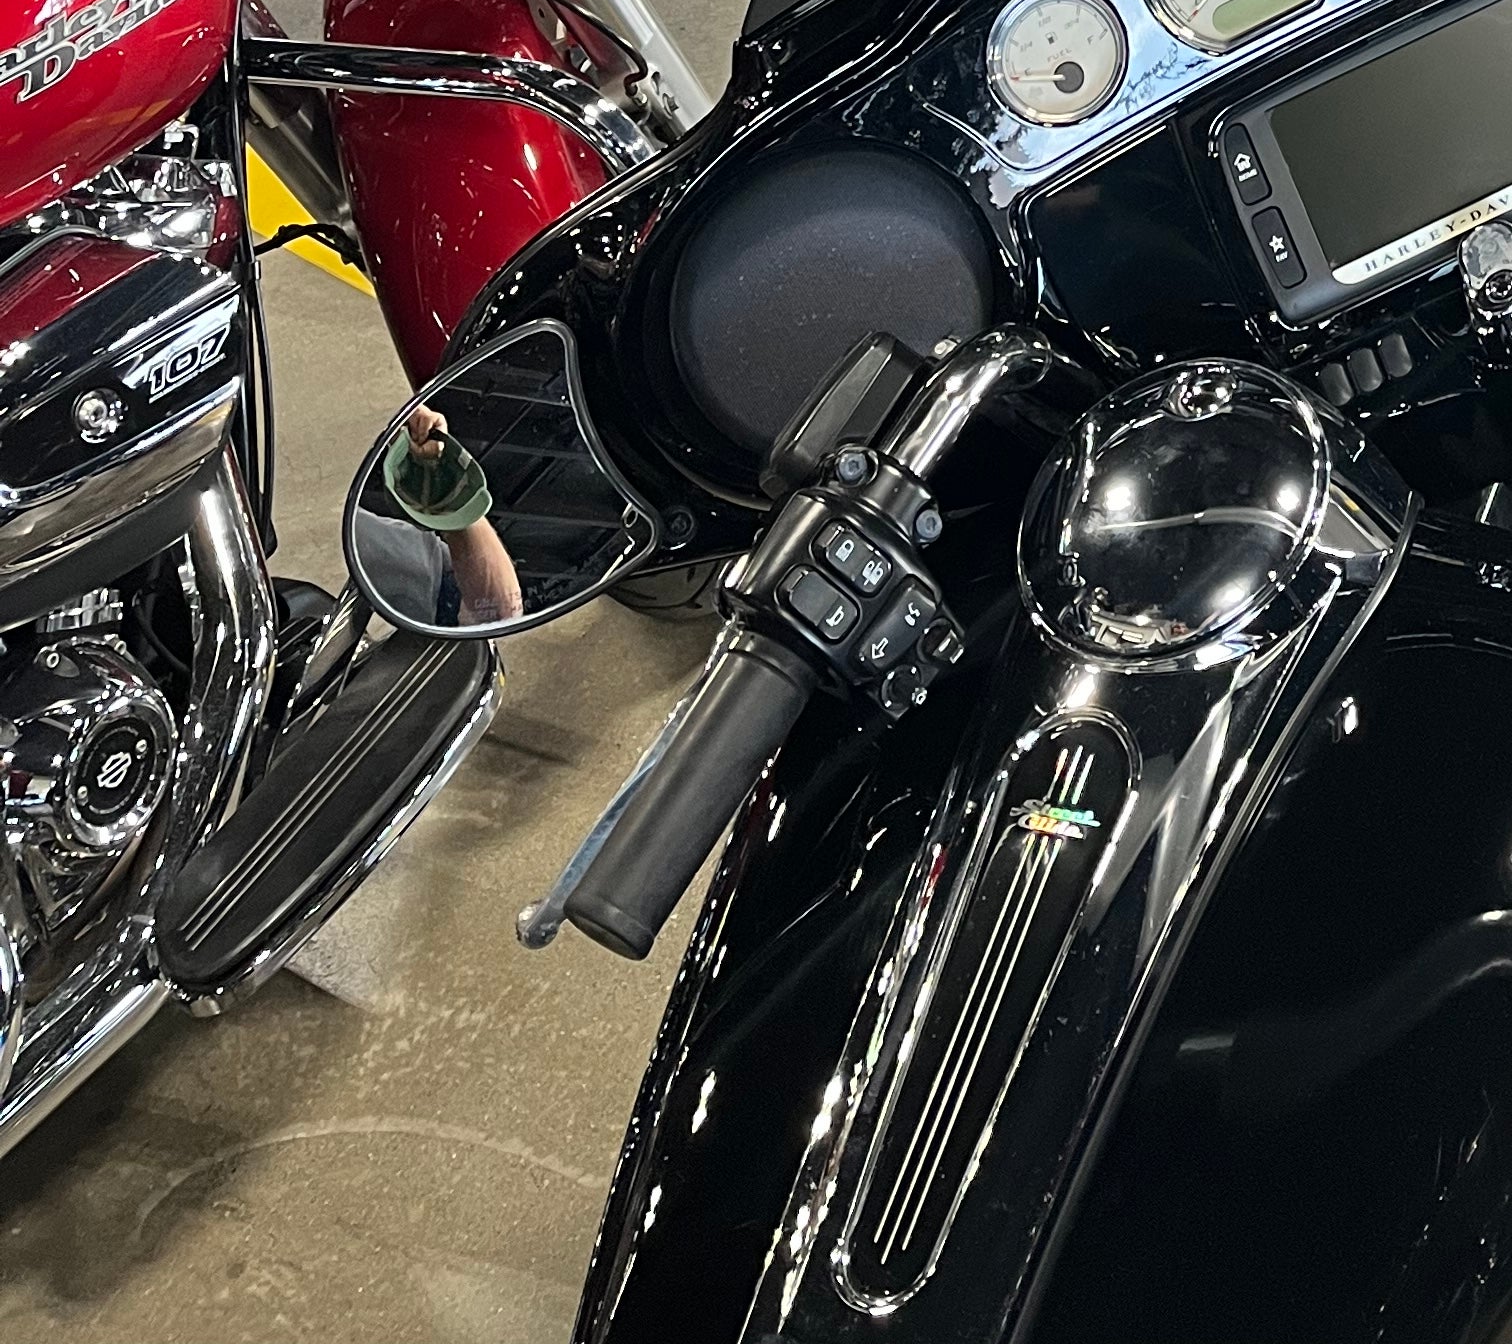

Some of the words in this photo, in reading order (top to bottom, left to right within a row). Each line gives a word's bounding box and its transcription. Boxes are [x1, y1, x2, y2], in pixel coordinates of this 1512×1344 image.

[1047, 48, 1072, 62] FUEL
[1239, 168, 1258, 182] HOME
[149, 322, 231, 395] 107
